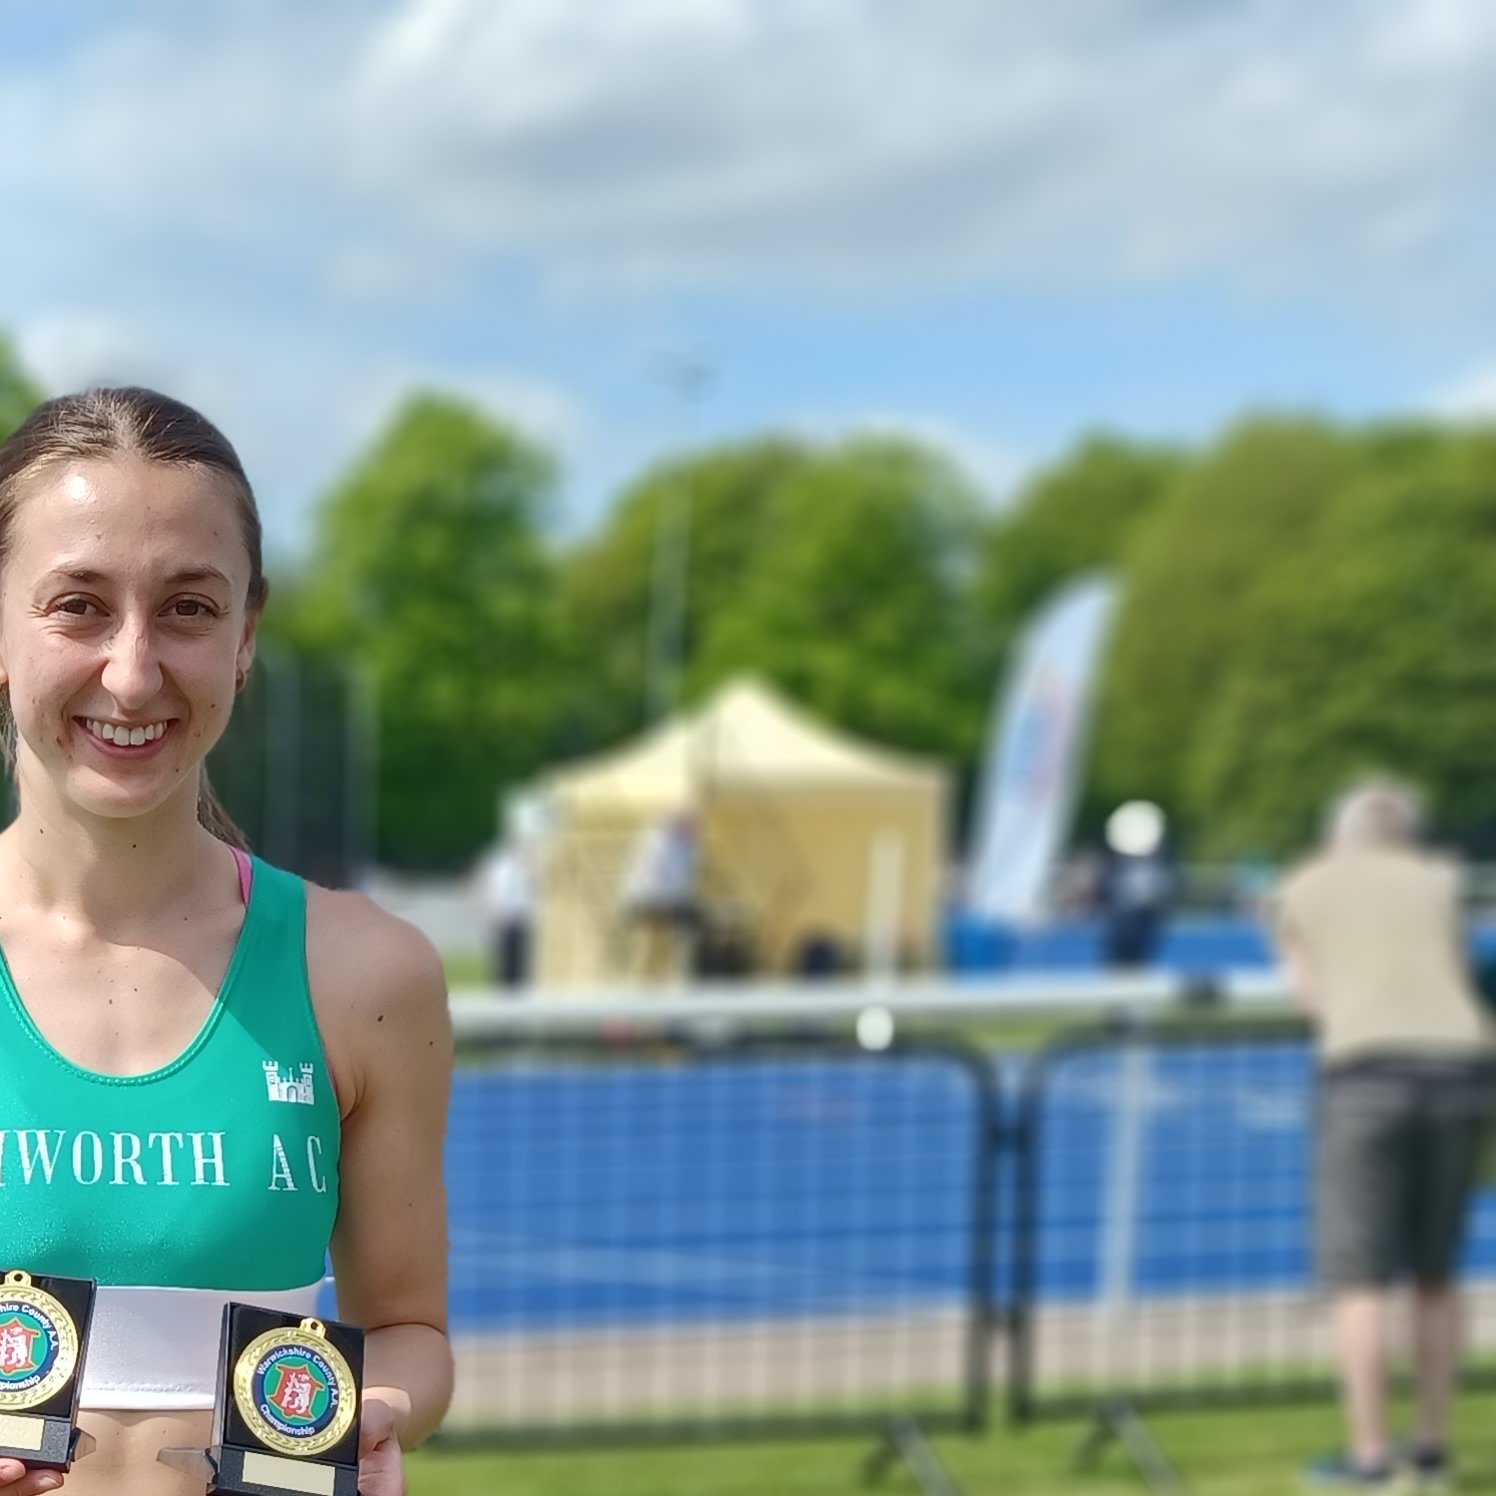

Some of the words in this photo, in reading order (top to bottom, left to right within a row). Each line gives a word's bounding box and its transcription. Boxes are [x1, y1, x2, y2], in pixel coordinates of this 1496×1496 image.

[22, 1304, 52, 1329] County
[257, 1347, 311, 1375] Warwickshire
[312, 1355, 336, 1386] County
[260, 1404, 315, 1435] Championship
